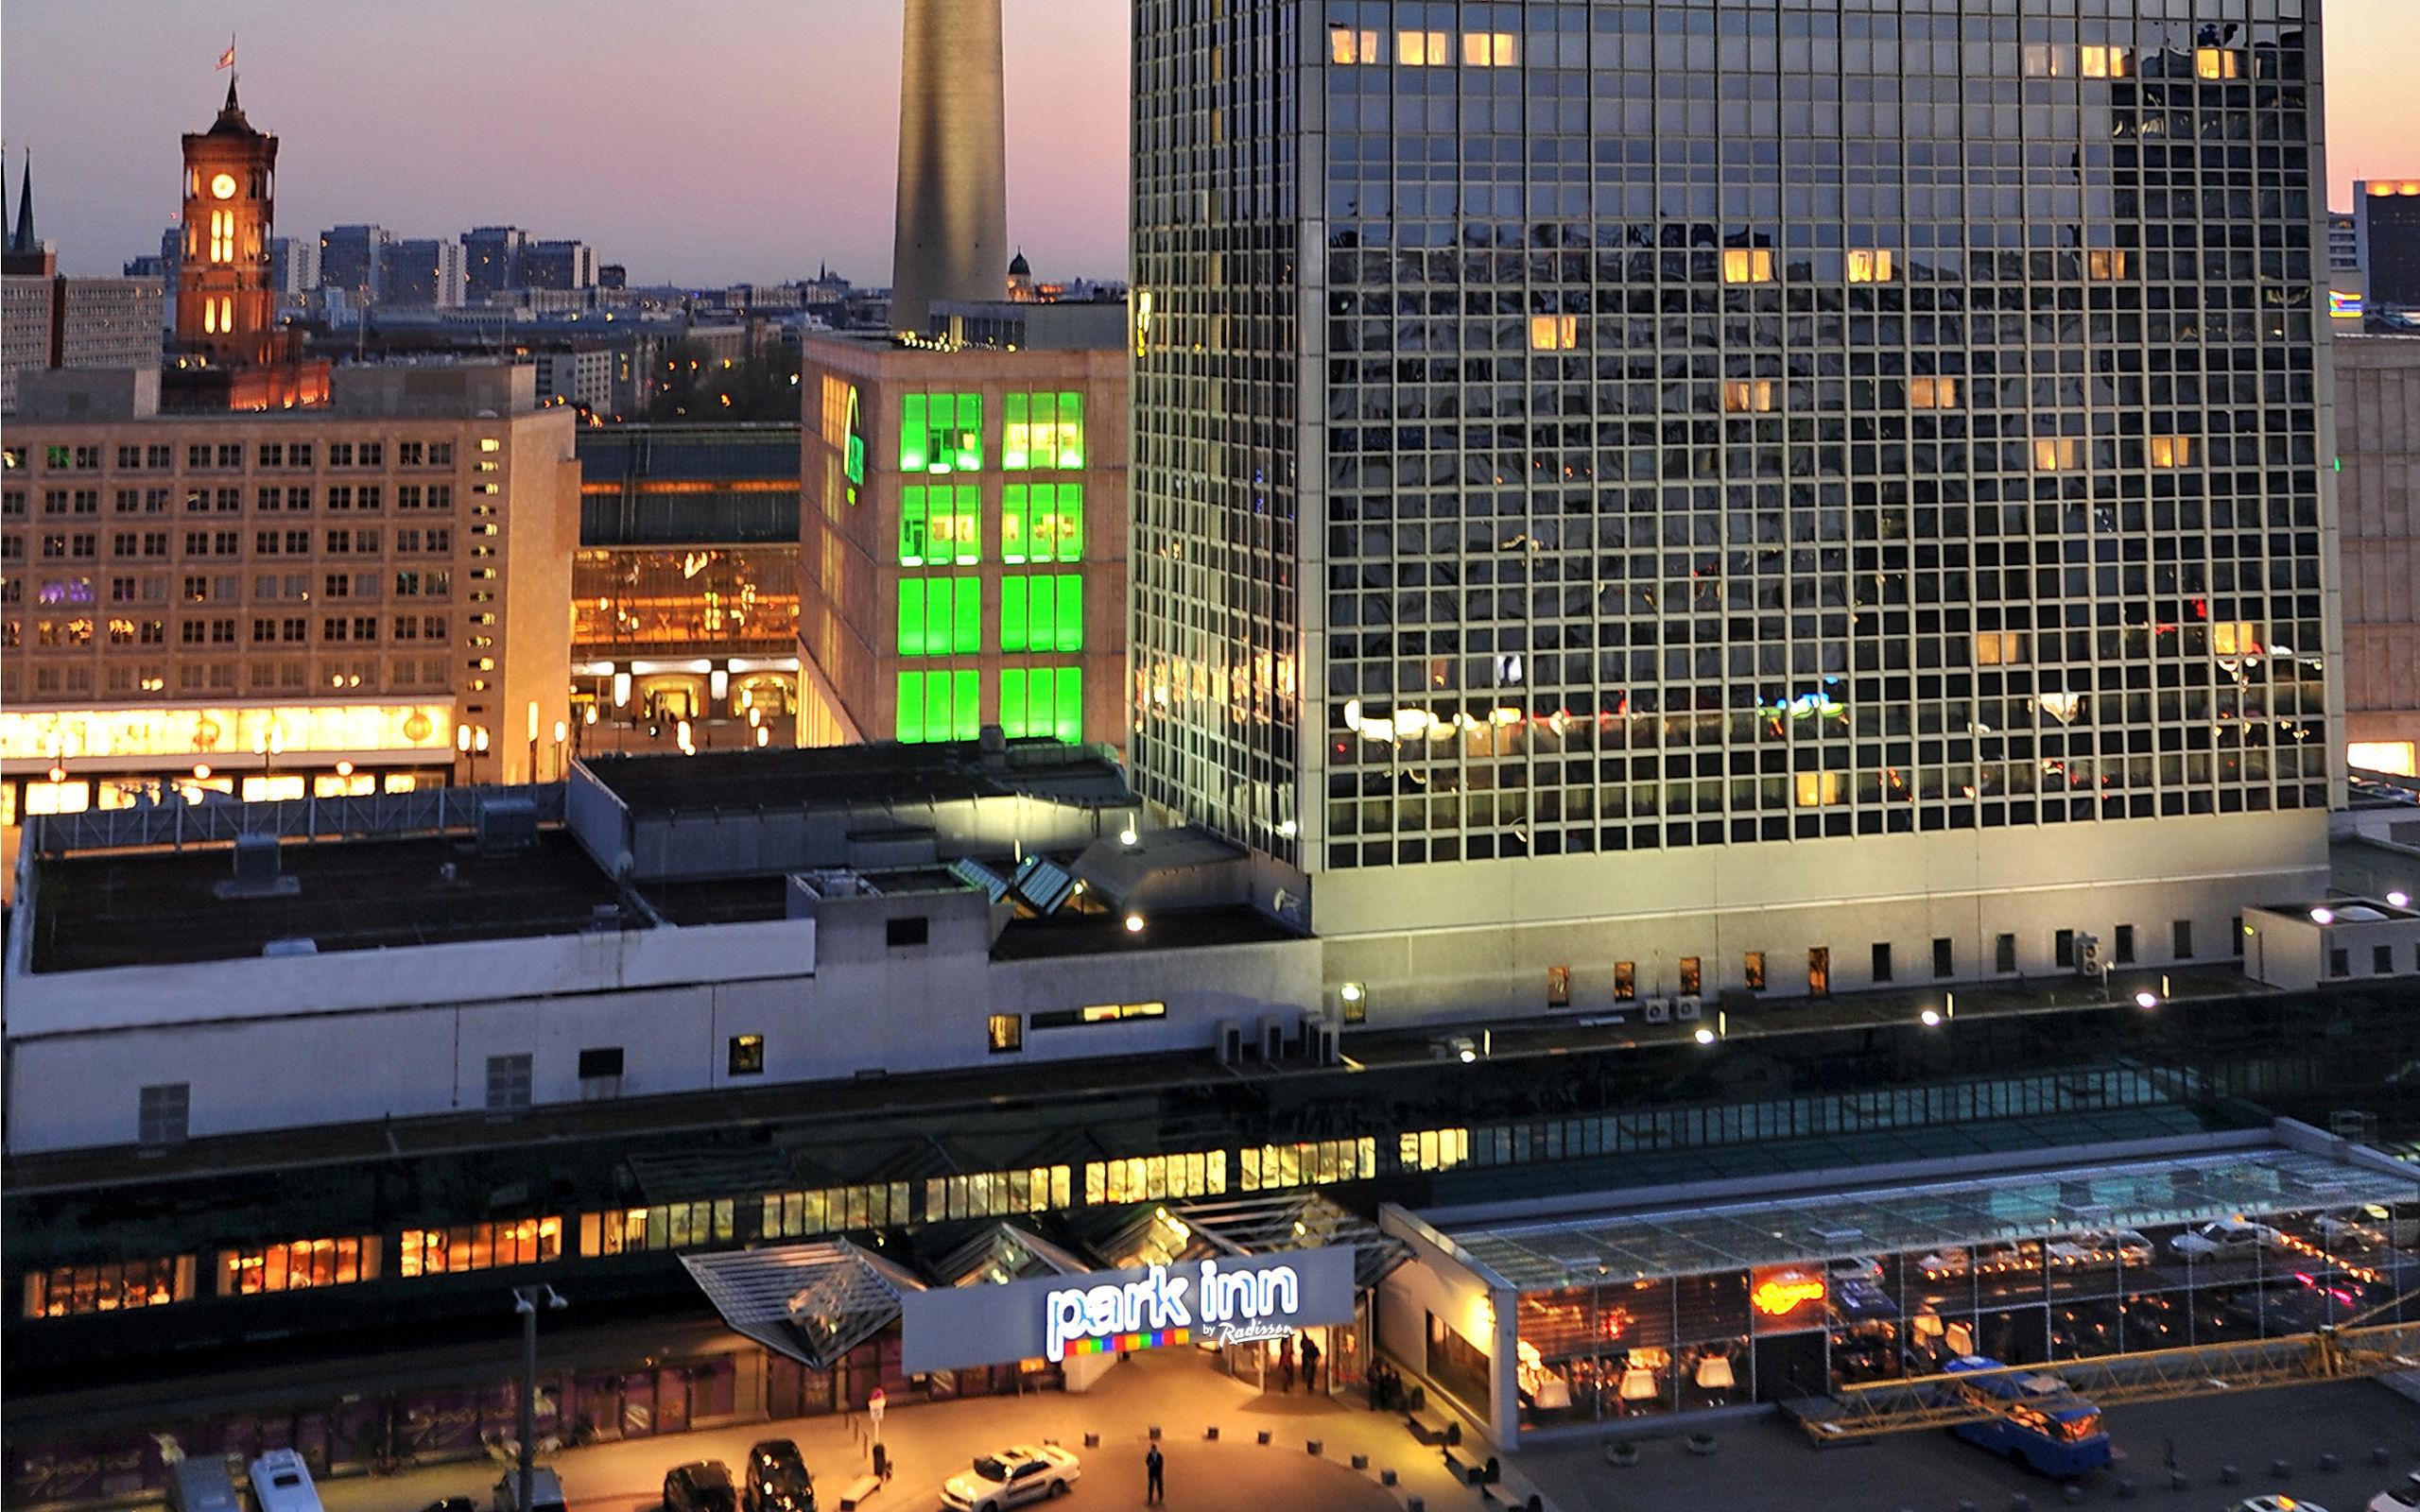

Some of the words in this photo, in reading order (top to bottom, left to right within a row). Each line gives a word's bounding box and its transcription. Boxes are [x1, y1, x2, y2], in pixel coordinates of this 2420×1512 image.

[1046, 1264, 1191, 1362] park
[1200, 1259, 1298, 1322] inn
[1202, 1324, 1216, 1337] by
[1219, 1317, 1294, 1349] Radisson
